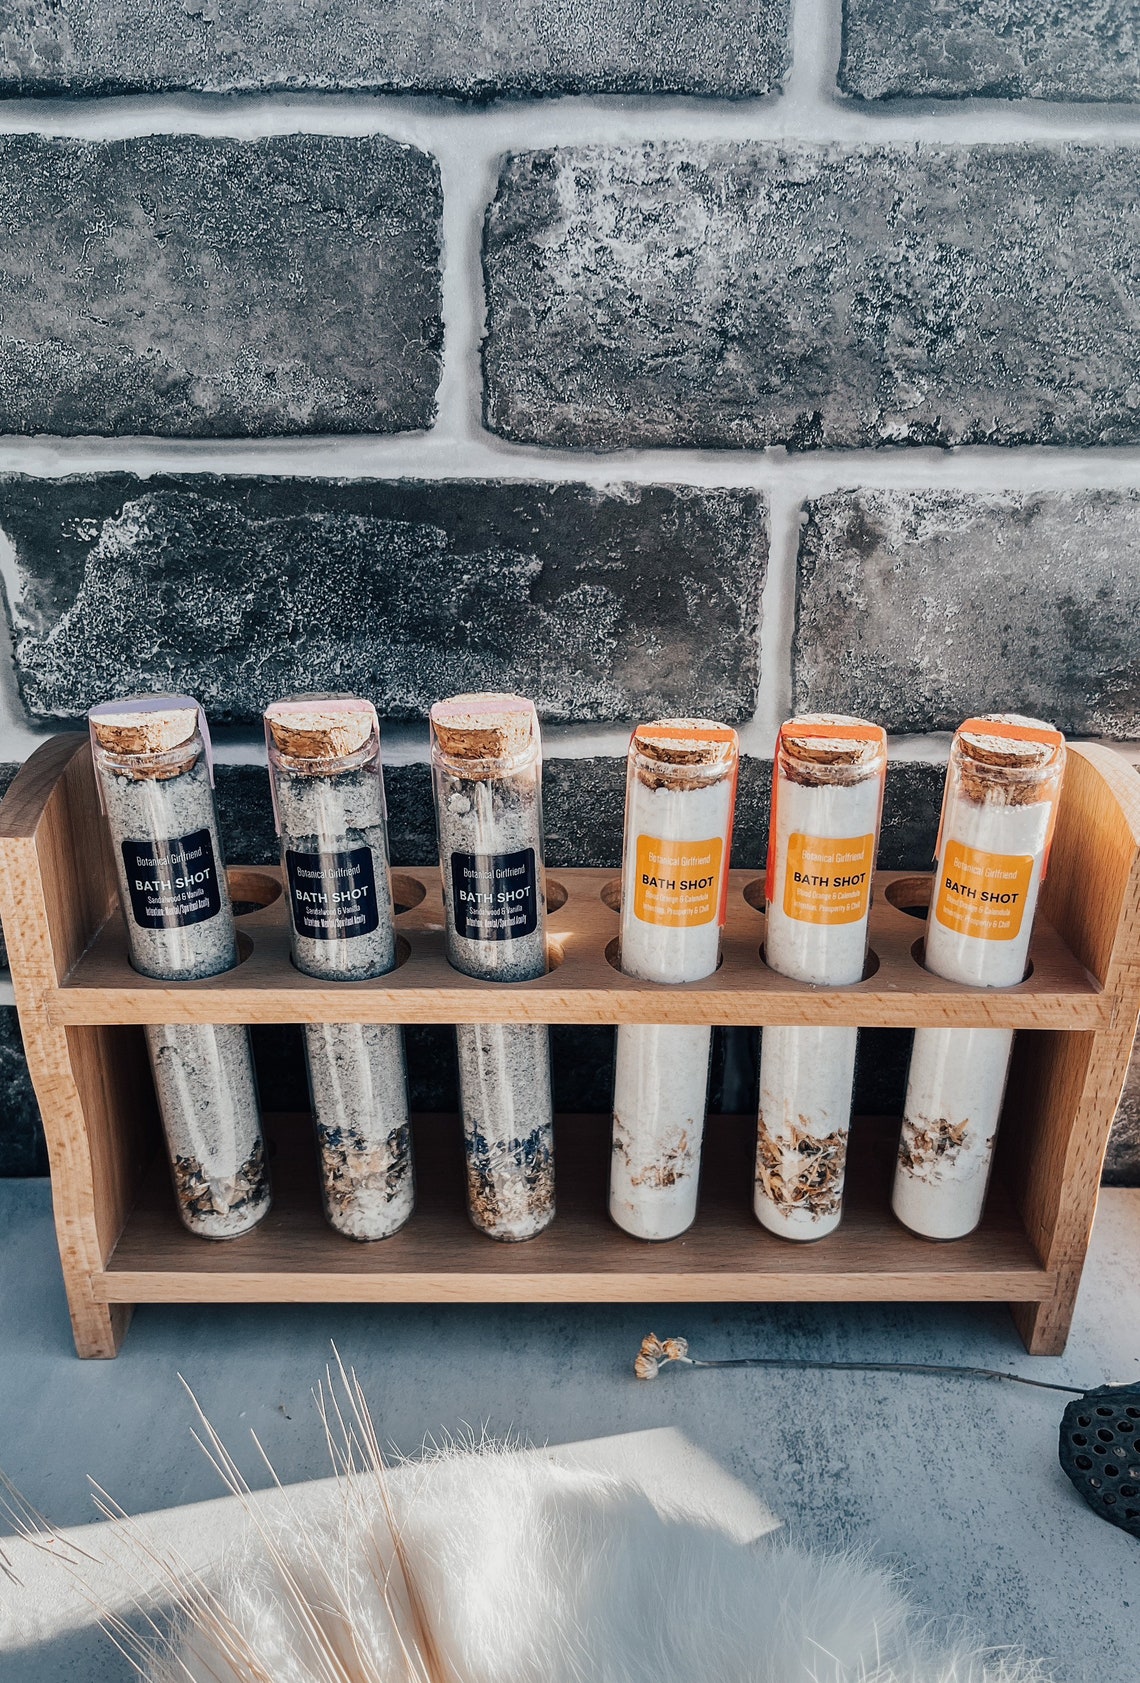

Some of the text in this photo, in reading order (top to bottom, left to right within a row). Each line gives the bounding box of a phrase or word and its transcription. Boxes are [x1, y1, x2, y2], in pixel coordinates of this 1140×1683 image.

[136, 846, 202, 866] Botanical Girlfriend
[649, 852, 711, 866] Botanical Girlfriend
[802, 849, 864, 863] Botanical Girlfriend
[297, 864, 360, 879] Botanical Girlfriend
[463, 864, 525, 879] Botanical Girlfriend
[953, 857, 1018, 879] Botanical Girlfriend
[135, 868, 210, 891] BATH SHOT
[642, 874, 714, 890] BATH SHOT
[794, 872, 866, 887] BATH SHOT
[296, 886, 368, 903] BATH SHOT
[460, 886, 531, 903] BATH SHOT
[945, 878, 1019, 904] BATH SHOT
